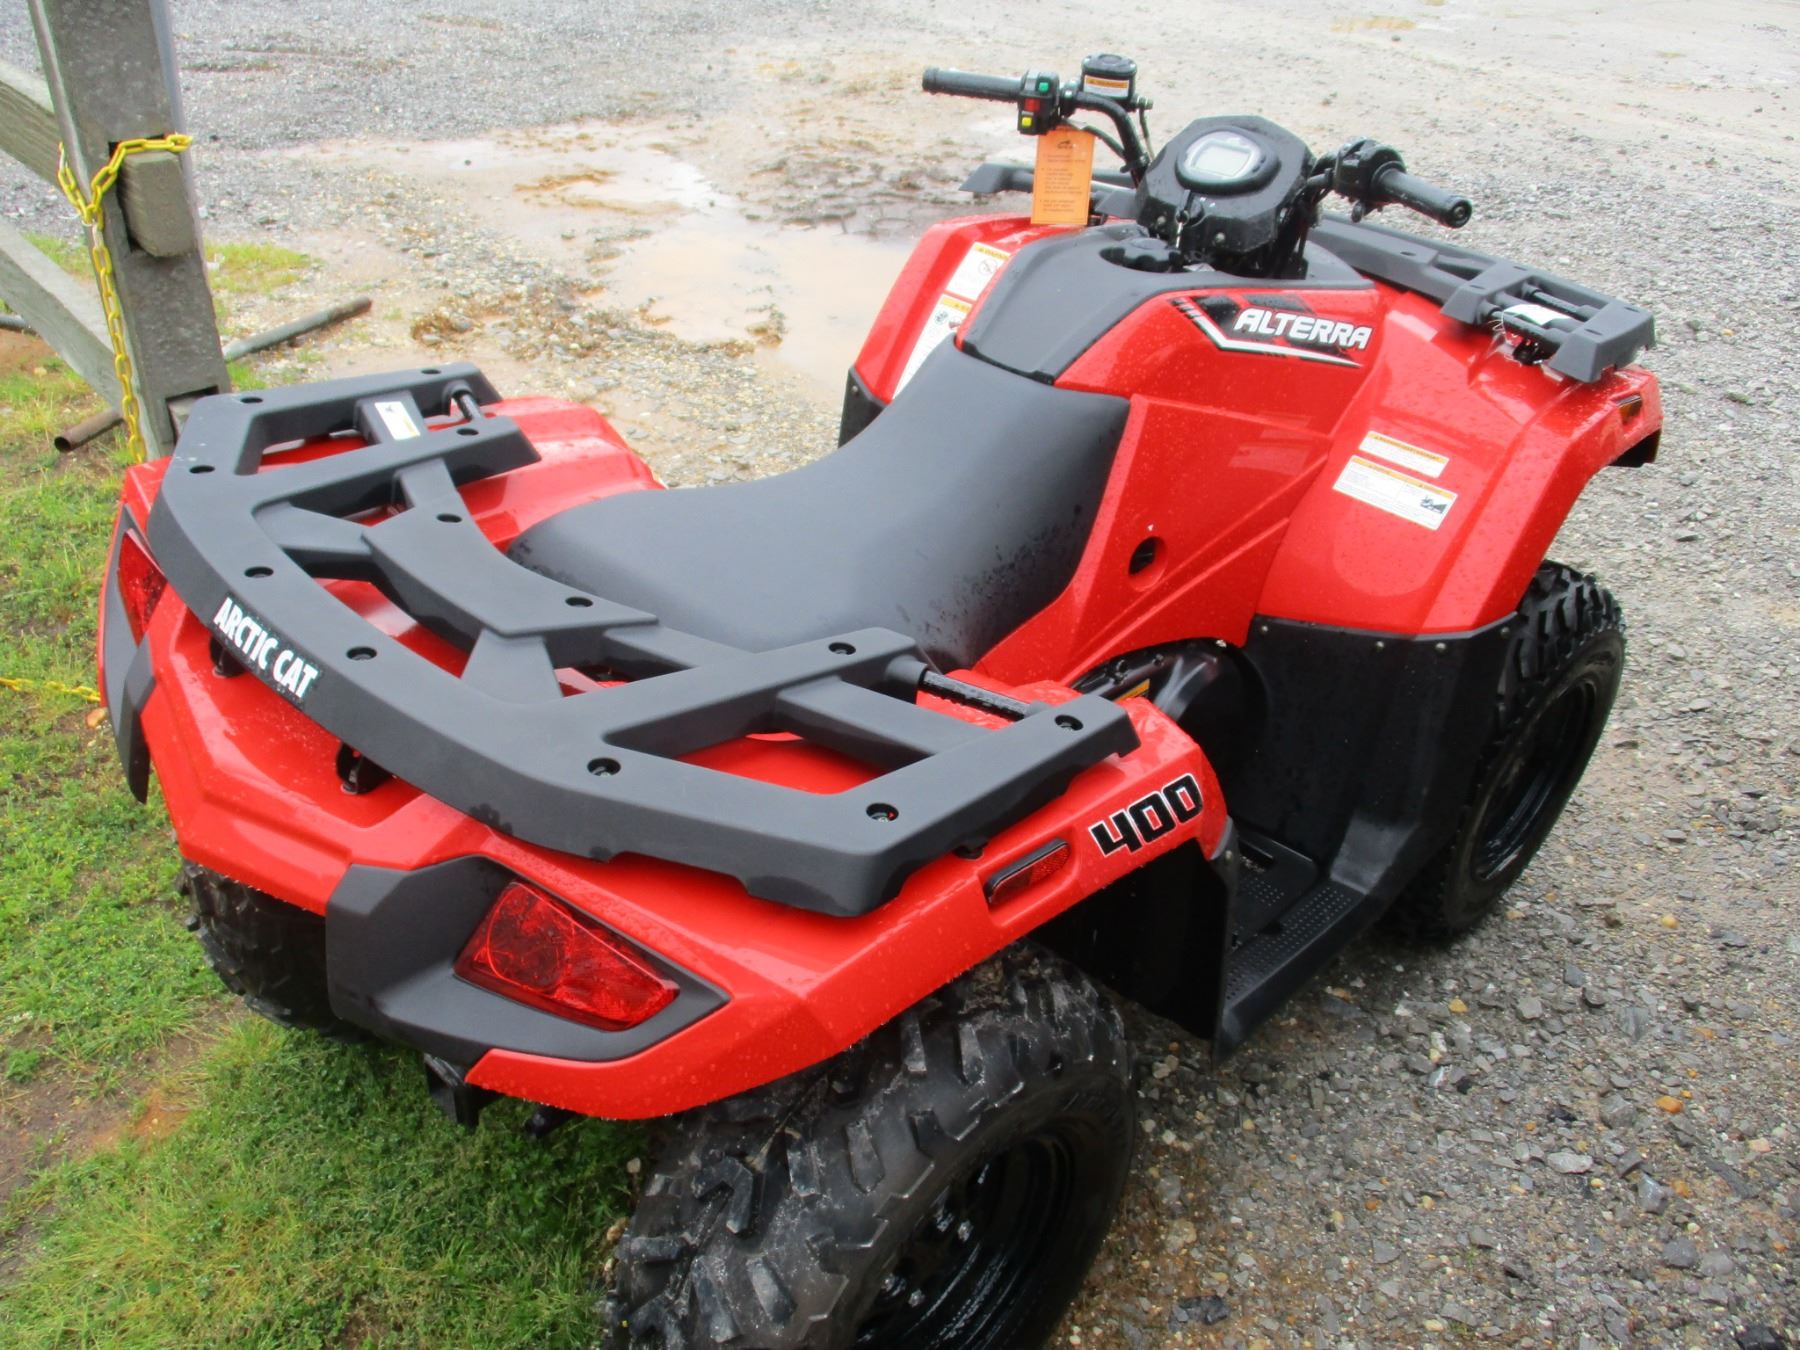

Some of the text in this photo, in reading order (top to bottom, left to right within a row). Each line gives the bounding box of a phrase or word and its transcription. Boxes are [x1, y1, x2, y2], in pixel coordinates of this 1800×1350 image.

[1234, 308, 1372, 349] ALTERRA
[213, 597, 318, 698] ARCTIC CAT
[1089, 773, 1203, 857] 400
